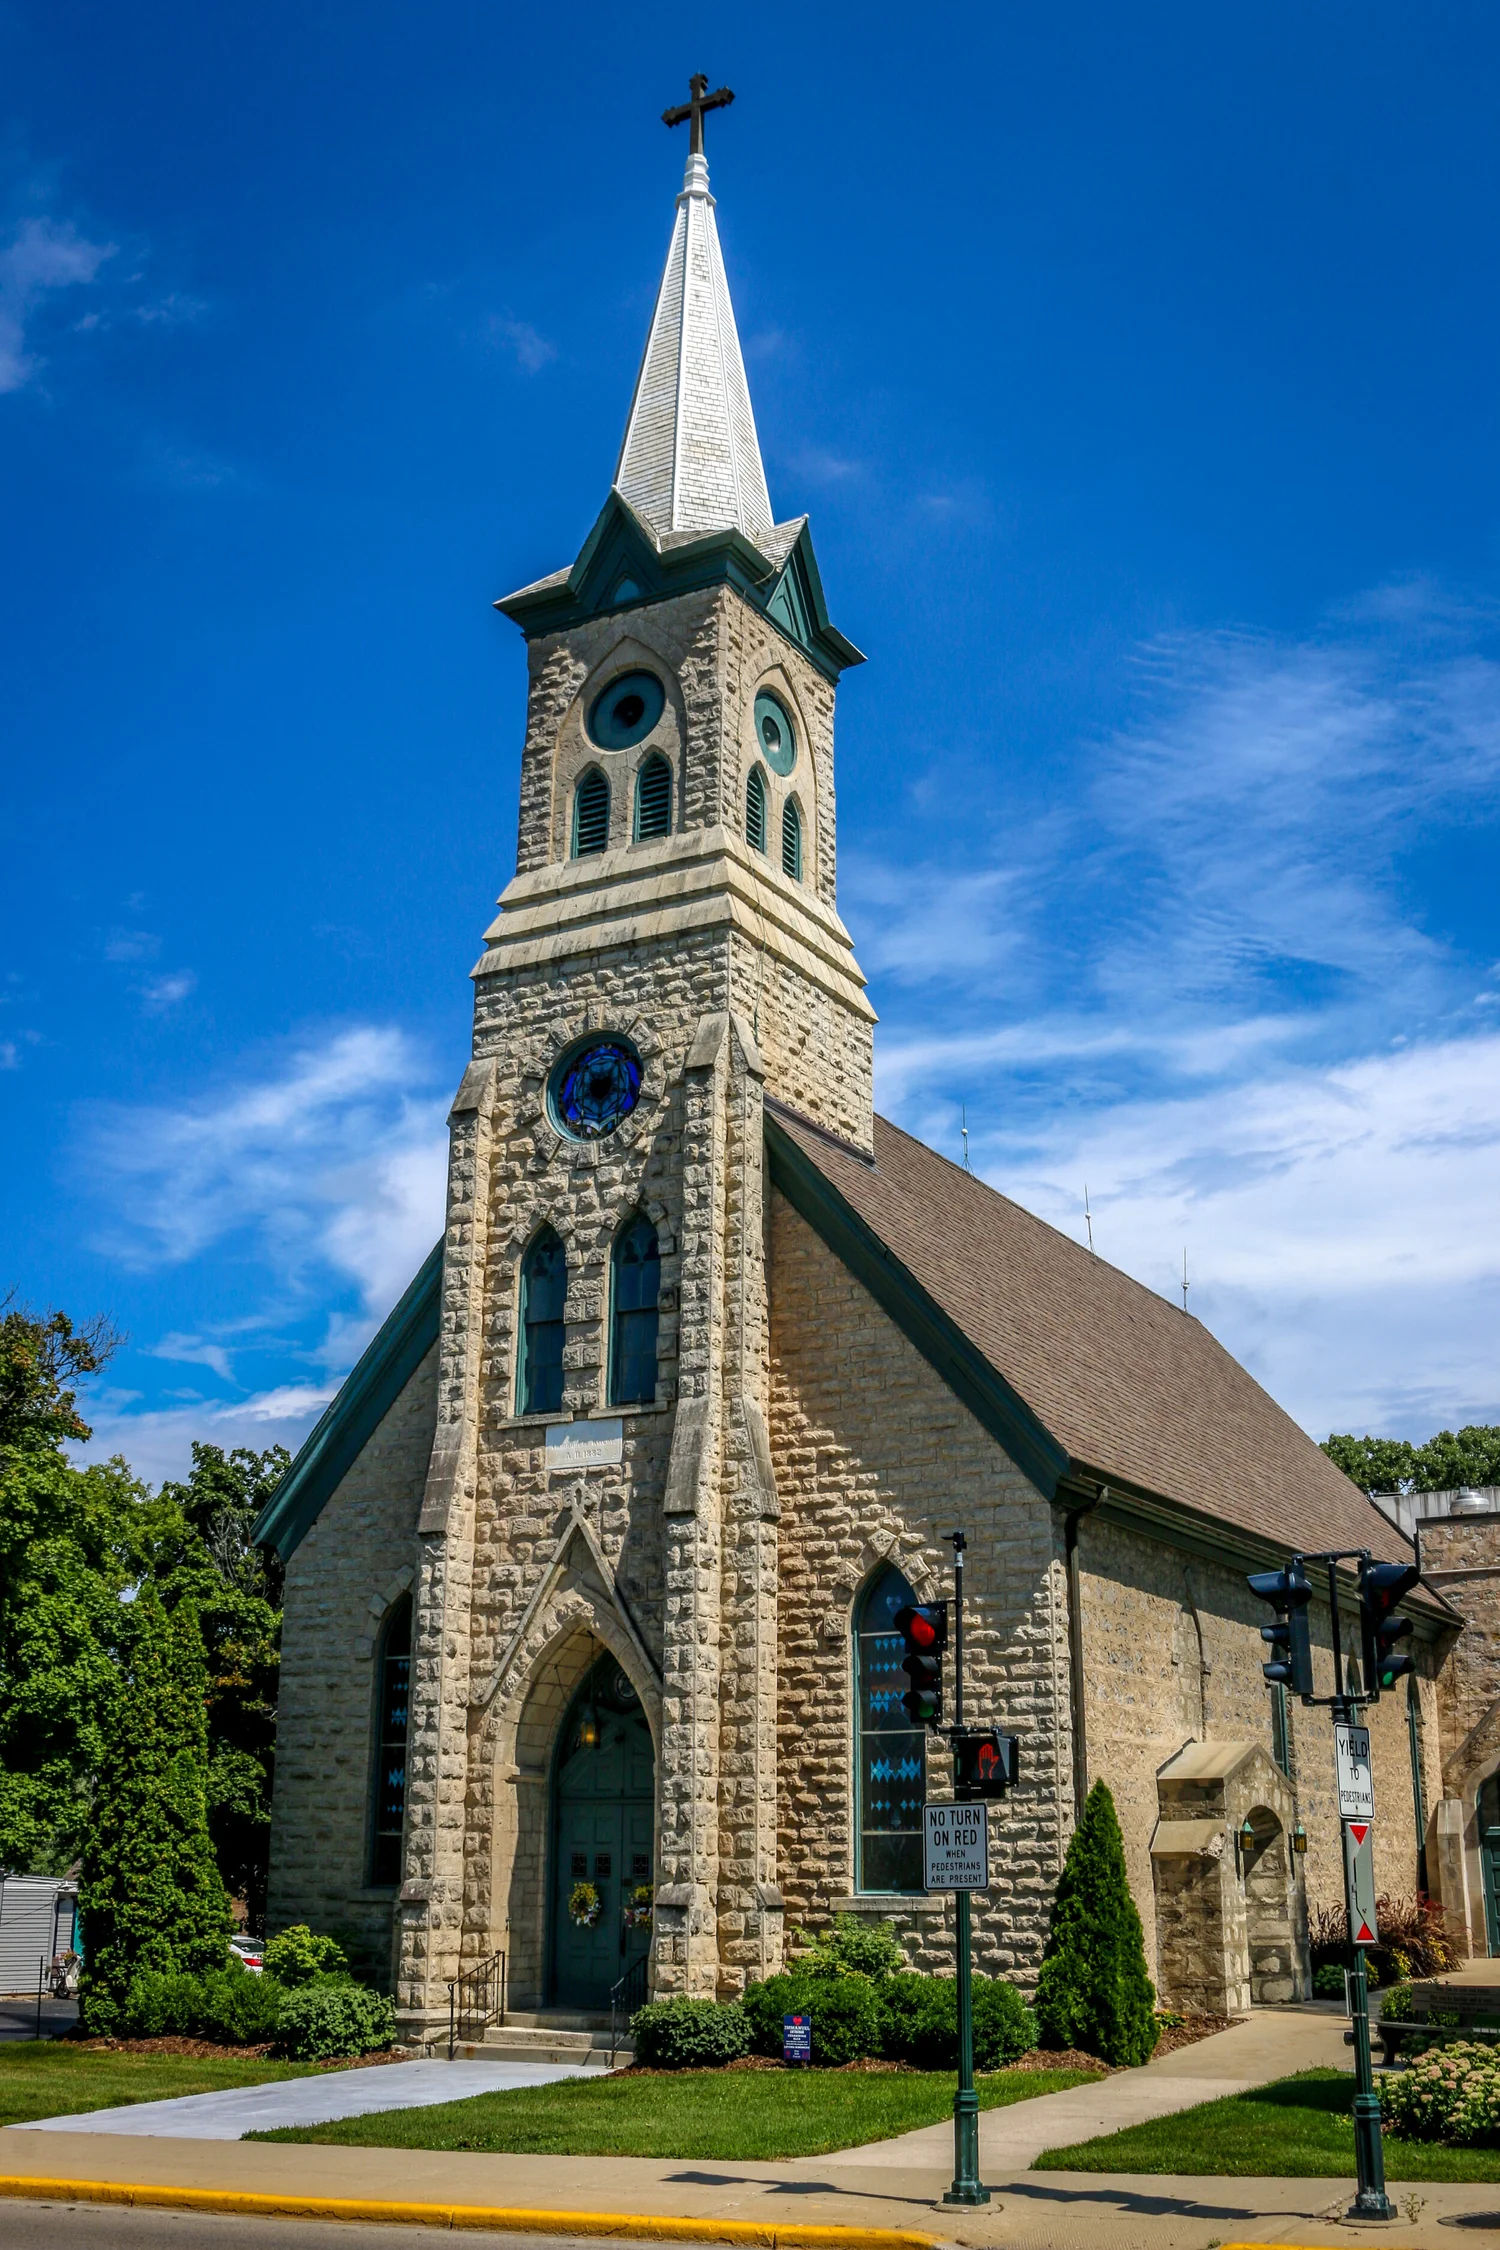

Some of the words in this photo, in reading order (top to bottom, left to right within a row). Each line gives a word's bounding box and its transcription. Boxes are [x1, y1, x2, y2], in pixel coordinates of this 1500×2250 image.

[1338, 1738, 1368, 1758] YIELD
[1349, 1767, 1360, 1780] TO
[1341, 1789, 1371, 1804] PEDESTRIANS
[930, 1811, 945, 1826] NO
[950, 1809, 980, 1826] TURN
[934, 1830, 949, 1846] ON
[954, 1829, 977, 1845] RED
[946, 1849, 966, 1858] WHEN
[931, 1861, 981, 1871] PEDESTRIANS
[931, 1875, 945, 1884] ARE
[950, 1874, 982, 1883] PRESENT
